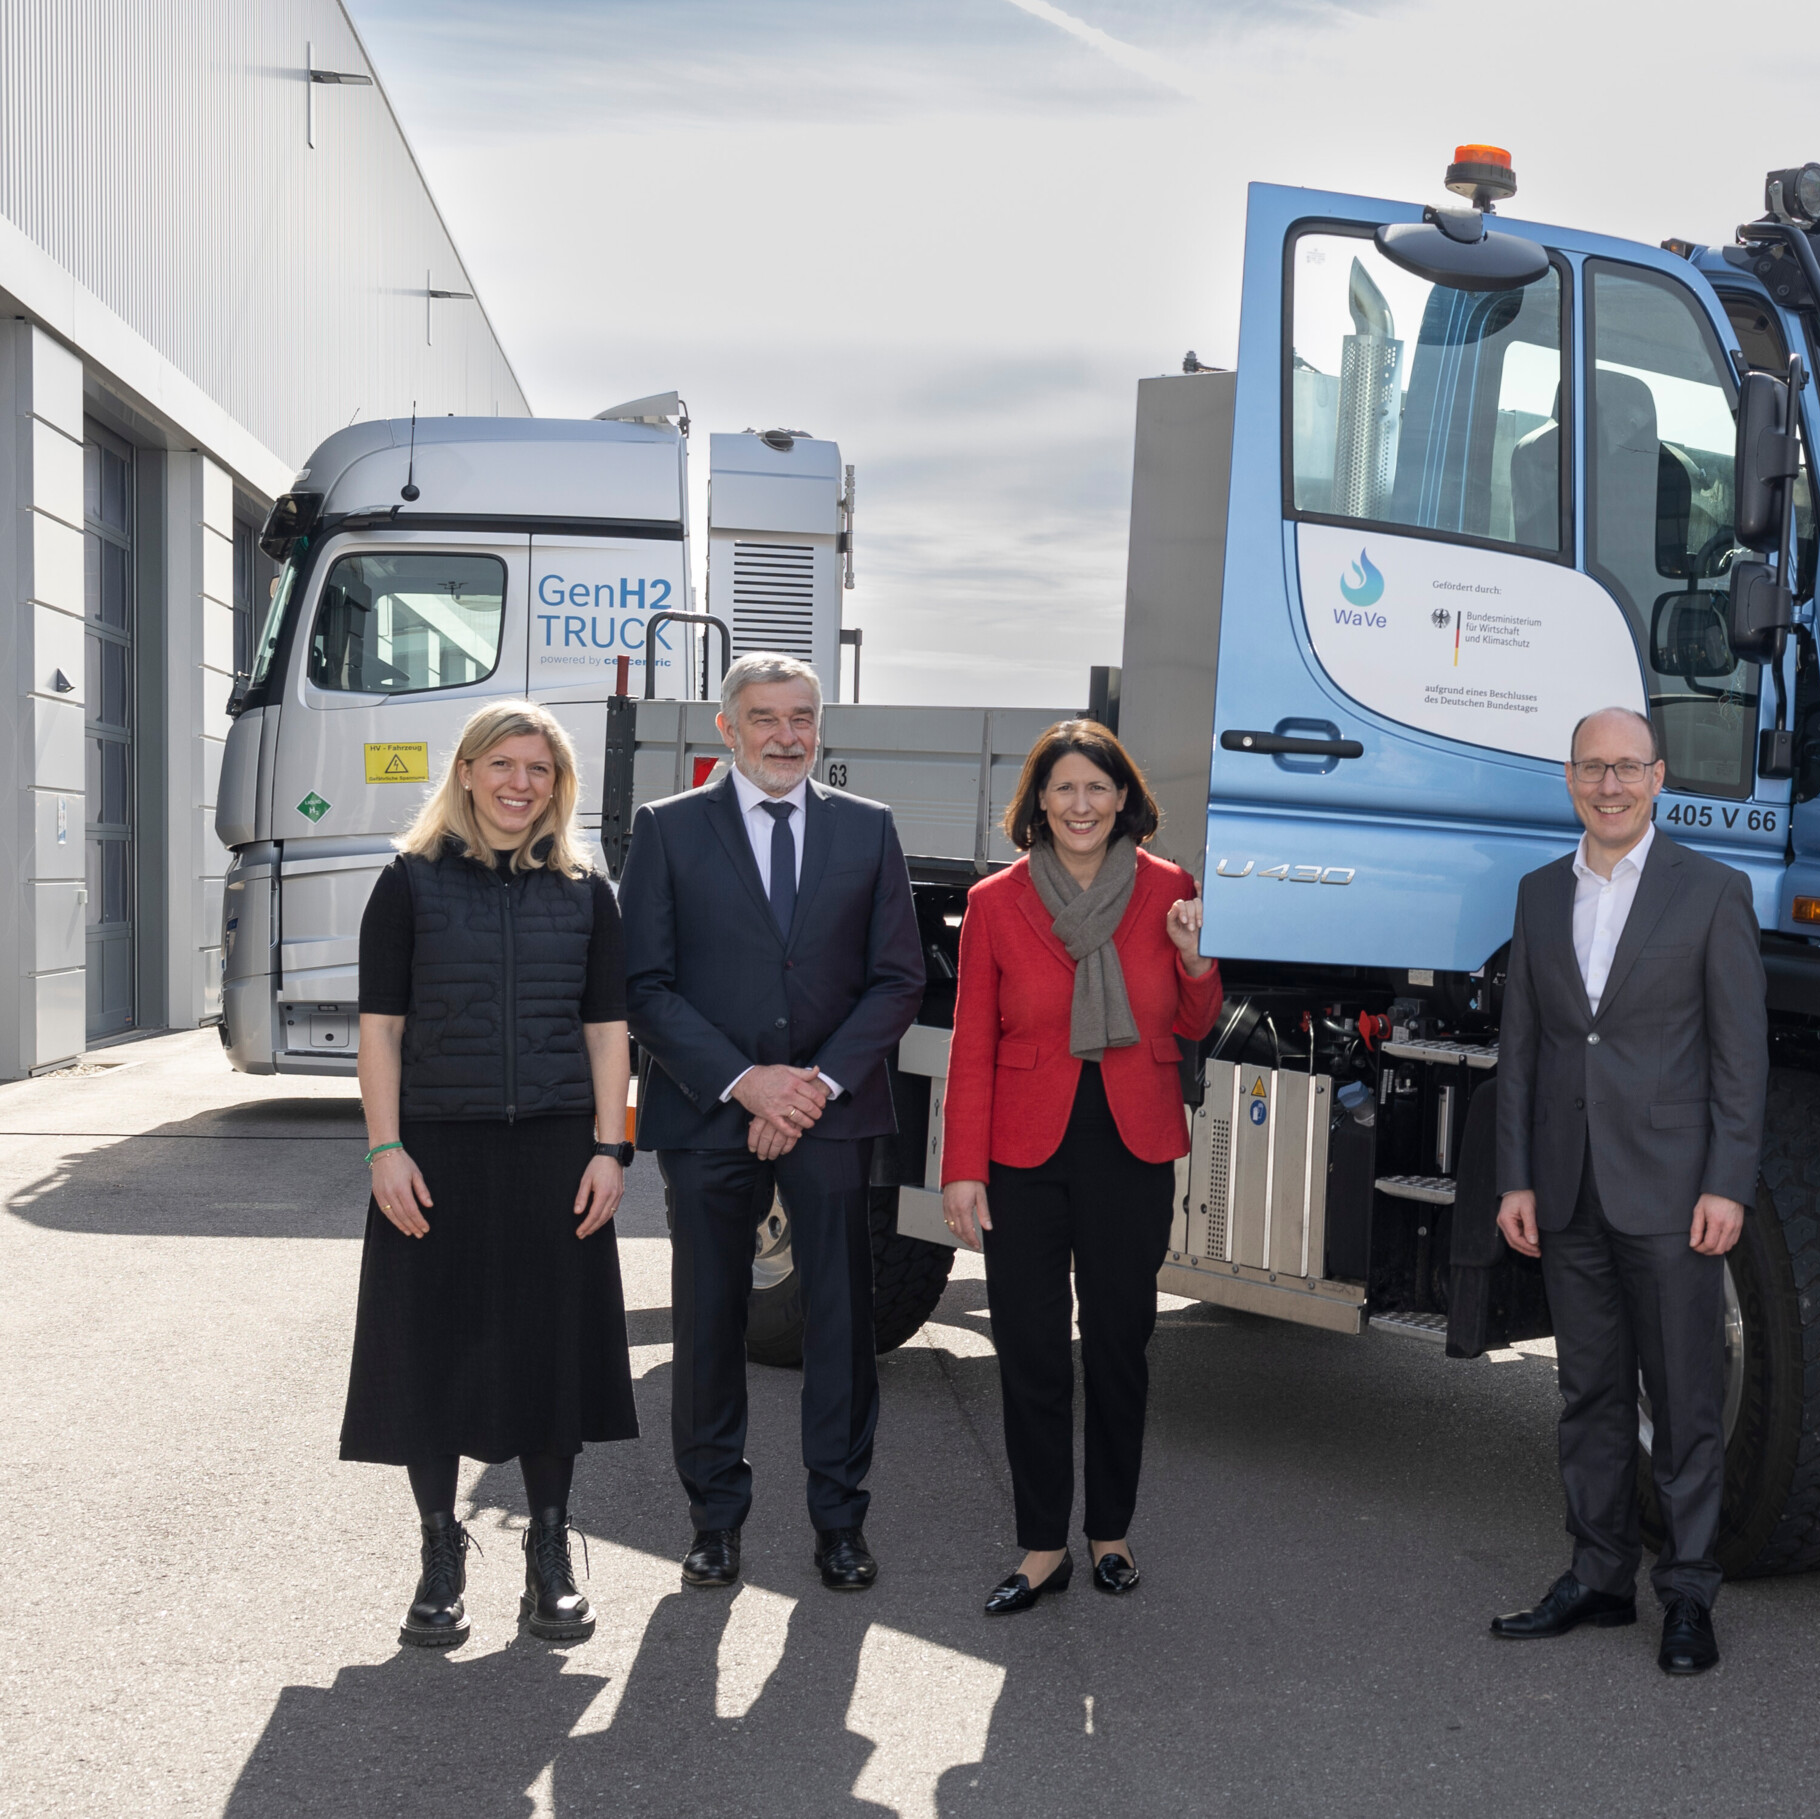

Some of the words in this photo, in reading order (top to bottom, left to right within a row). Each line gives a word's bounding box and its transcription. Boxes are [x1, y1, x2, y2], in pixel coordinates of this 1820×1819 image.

[538, 574, 672, 610] GenH2
[1432, 580, 1473, 593] Gefördert
[1475, 583, 1502, 595] durch:
[1333, 608, 1387, 628] WaVe
[1466, 611, 1542, 627] Bundesministerium
[537, 614, 672, 650] TRUCK
[1466, 623, 1478, 632] für
[1479, 624, 1520, 636] Wirtschaft
[1465, 634, 1481, 644] und
[1482, 635, 1530, 648] Klimaschutz
[540, 655, 586, 665] powered
[588, 656, 600, 666] by
[1425, 684, 1464, 696] aufgrund
[1466, 688, 1488, 697] eines
[1490, 689, 1538, 702] Beschlusses
[1424, 695, 1438, 704] des
[1440, 697, 1485, 708] Deutschen
[1486, 700, 1538, 714] Bundestages
[829, 764, 847, 787] 63
[1666, 804, 1712, 827] 405
[1722, 807, 1740, 828] V
[1748, 810, 1776, 832] 66
[1216, 858, 1255, 878] U
[1257, 863, 1356, 885] 430
